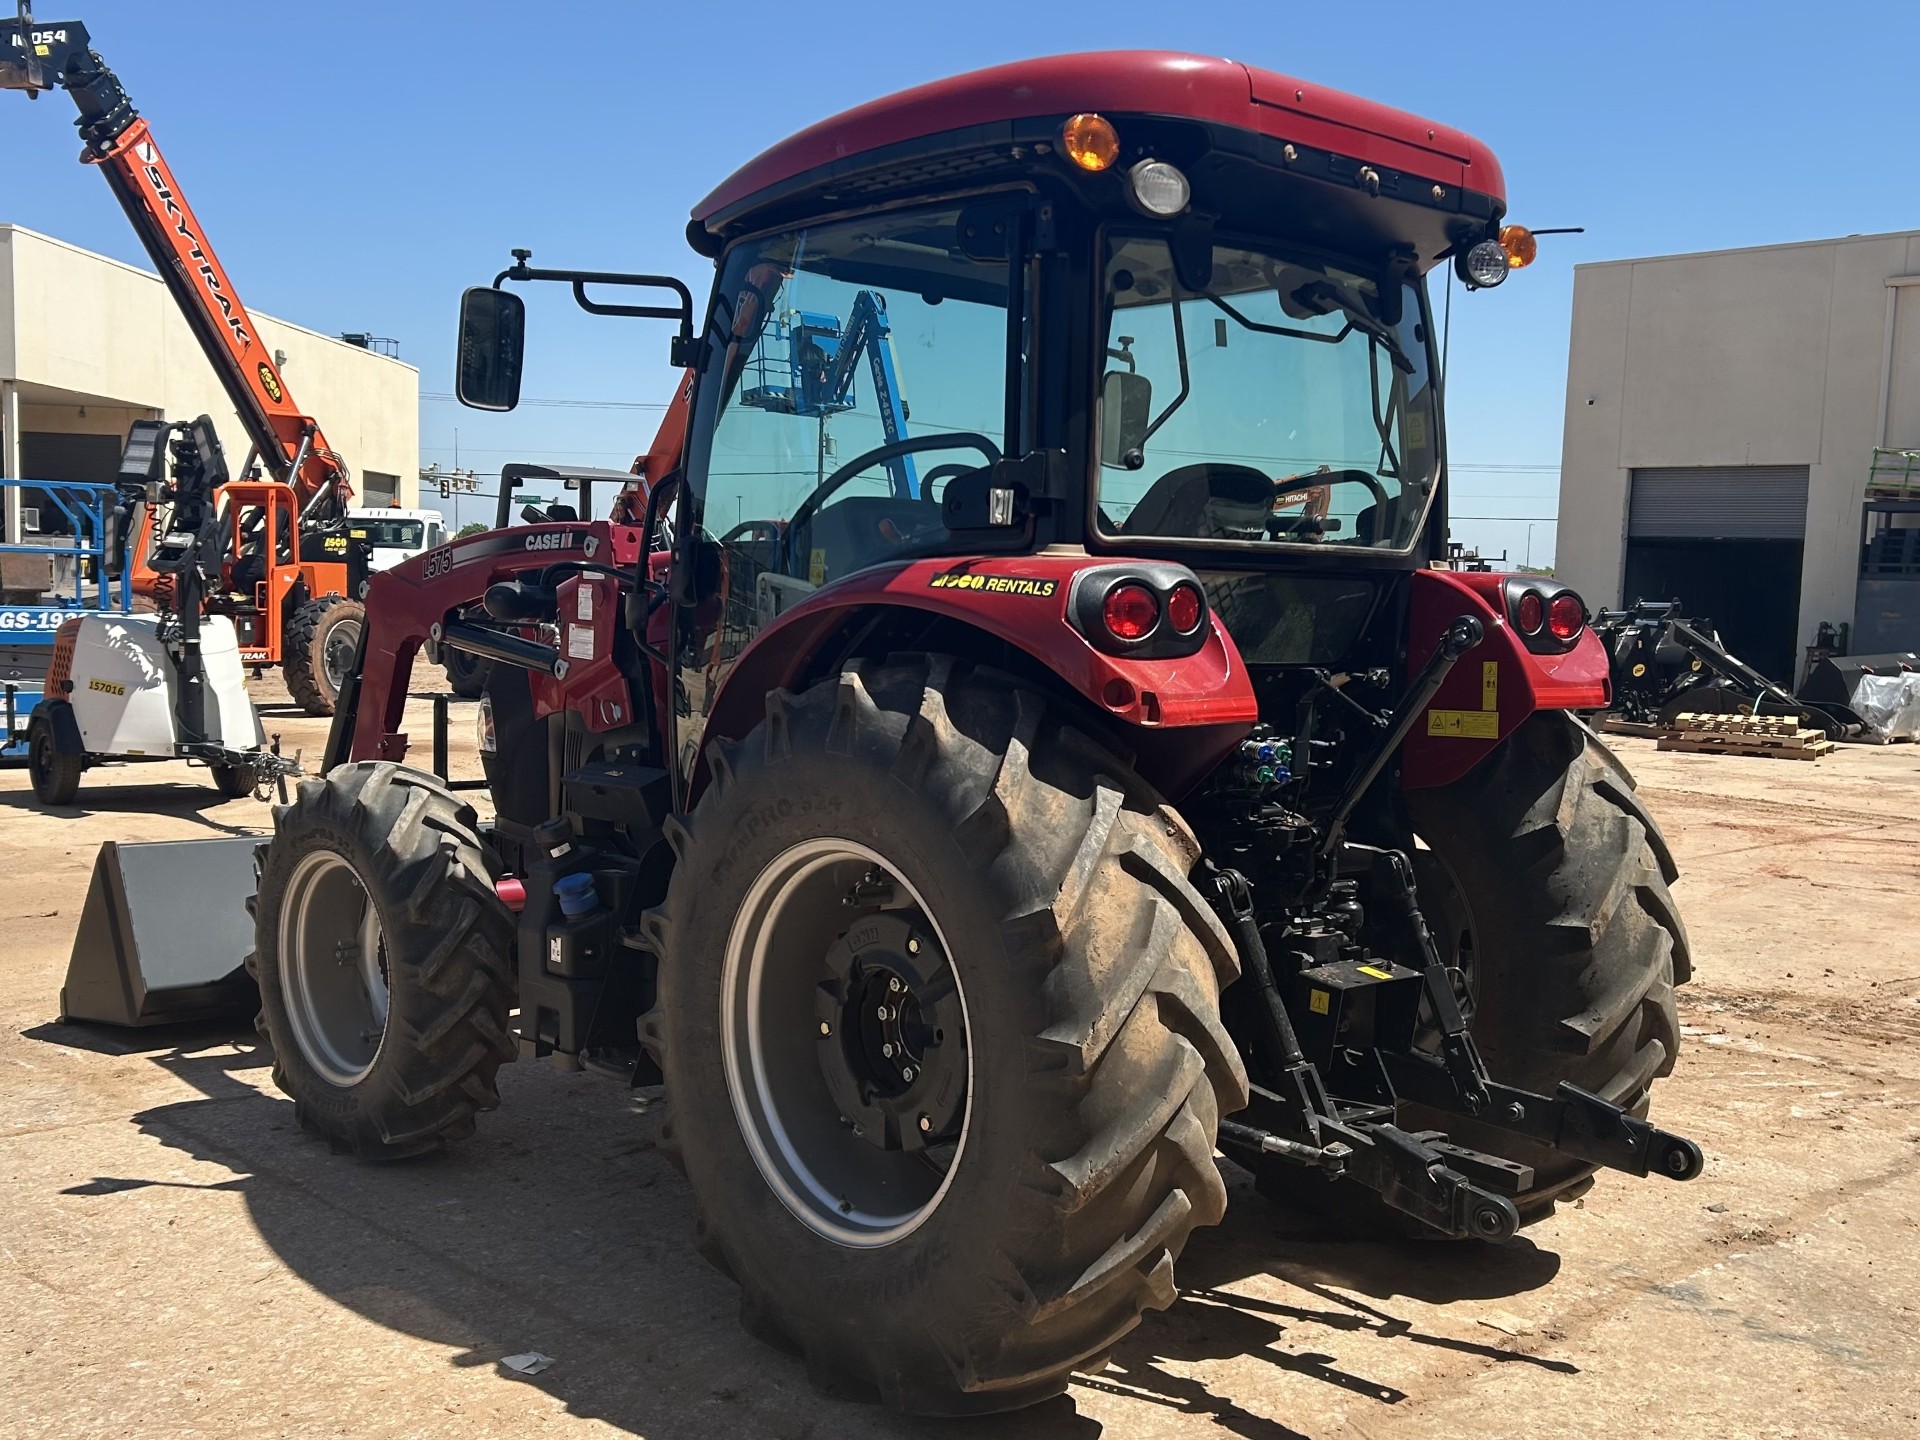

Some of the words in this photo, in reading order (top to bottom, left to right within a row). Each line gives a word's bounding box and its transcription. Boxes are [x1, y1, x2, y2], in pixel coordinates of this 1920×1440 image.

[142, 165, 251, 348] SKYTRAK
[1285, 493, 1308, 503] HITACHI
[422, 546, 453, 580] L575
[930, 574, 986, 590] ASCO
[985, 578, 1055, 597] RENTALS
[0, 611, 90, 629] GS-19
[88, 681, 126, 696] 157016
